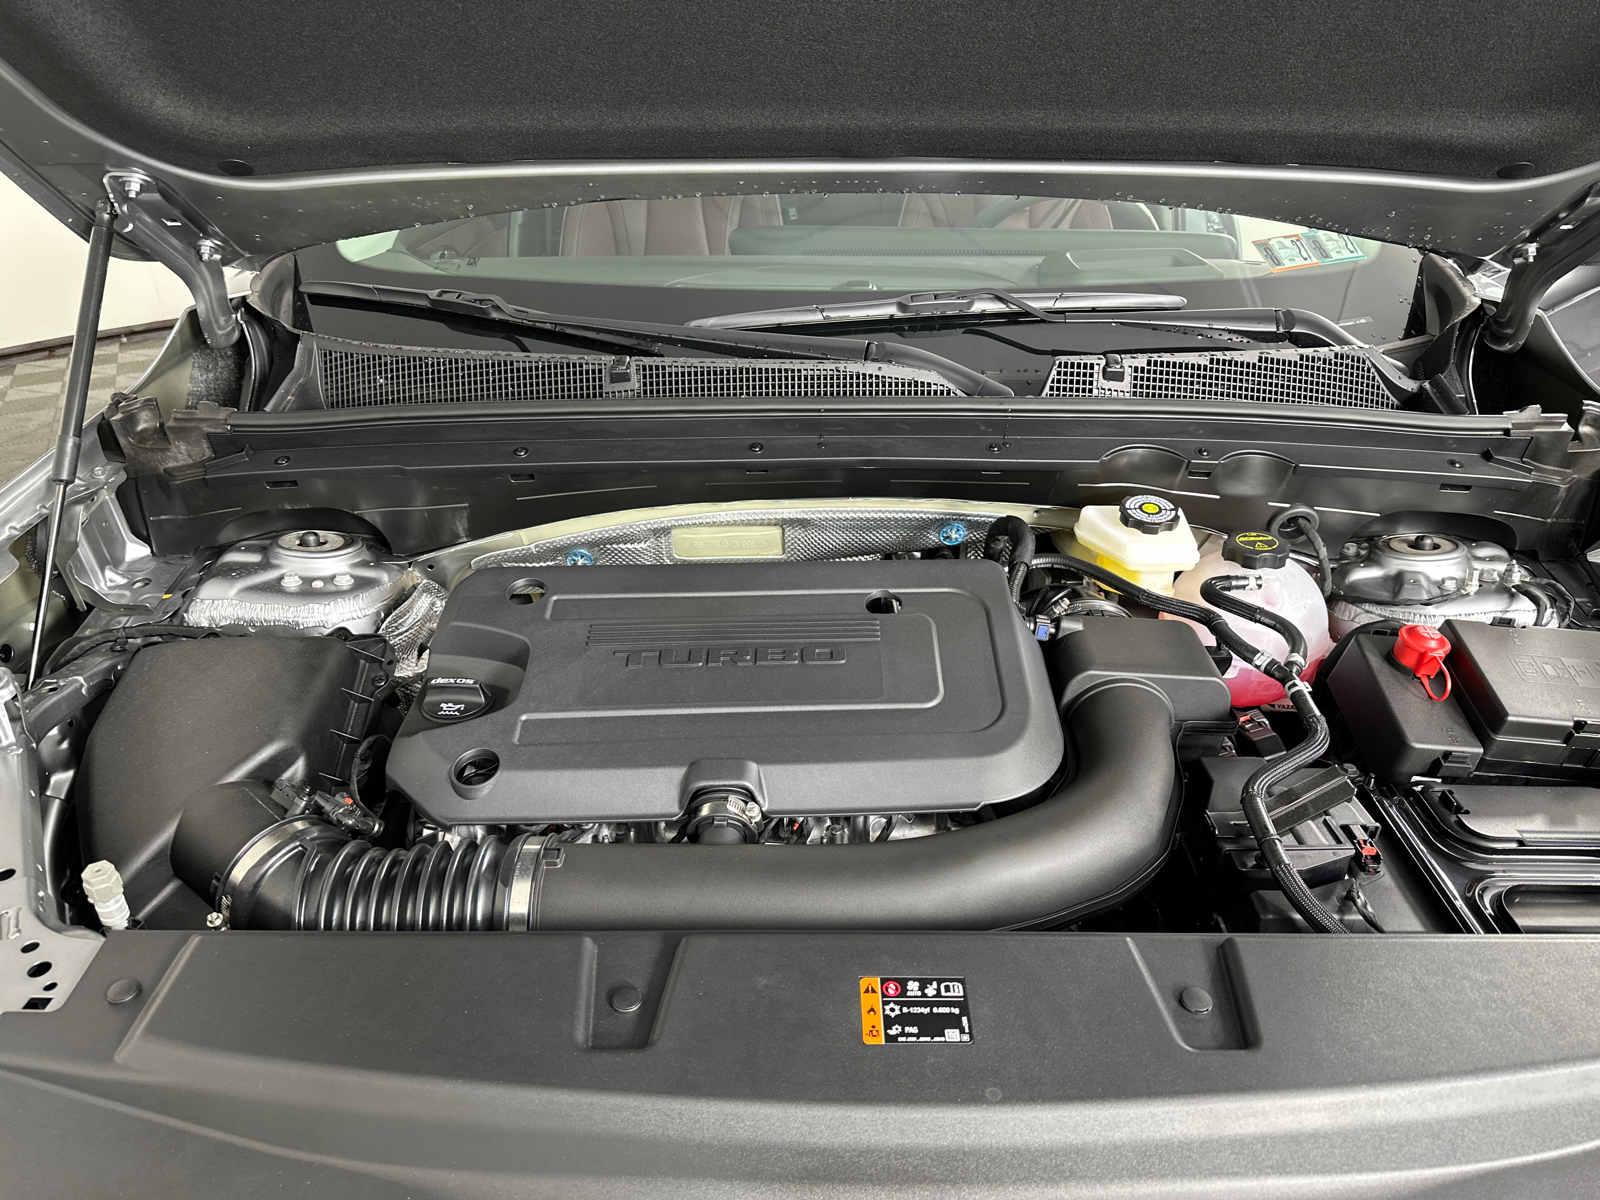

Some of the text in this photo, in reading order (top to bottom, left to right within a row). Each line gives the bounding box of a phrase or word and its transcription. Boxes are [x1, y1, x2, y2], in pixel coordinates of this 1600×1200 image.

[612, 647, 847, 668] TURBO
[951, 1006, 960, 1015] kg
[904, 1026, 919, 1034] PAG
